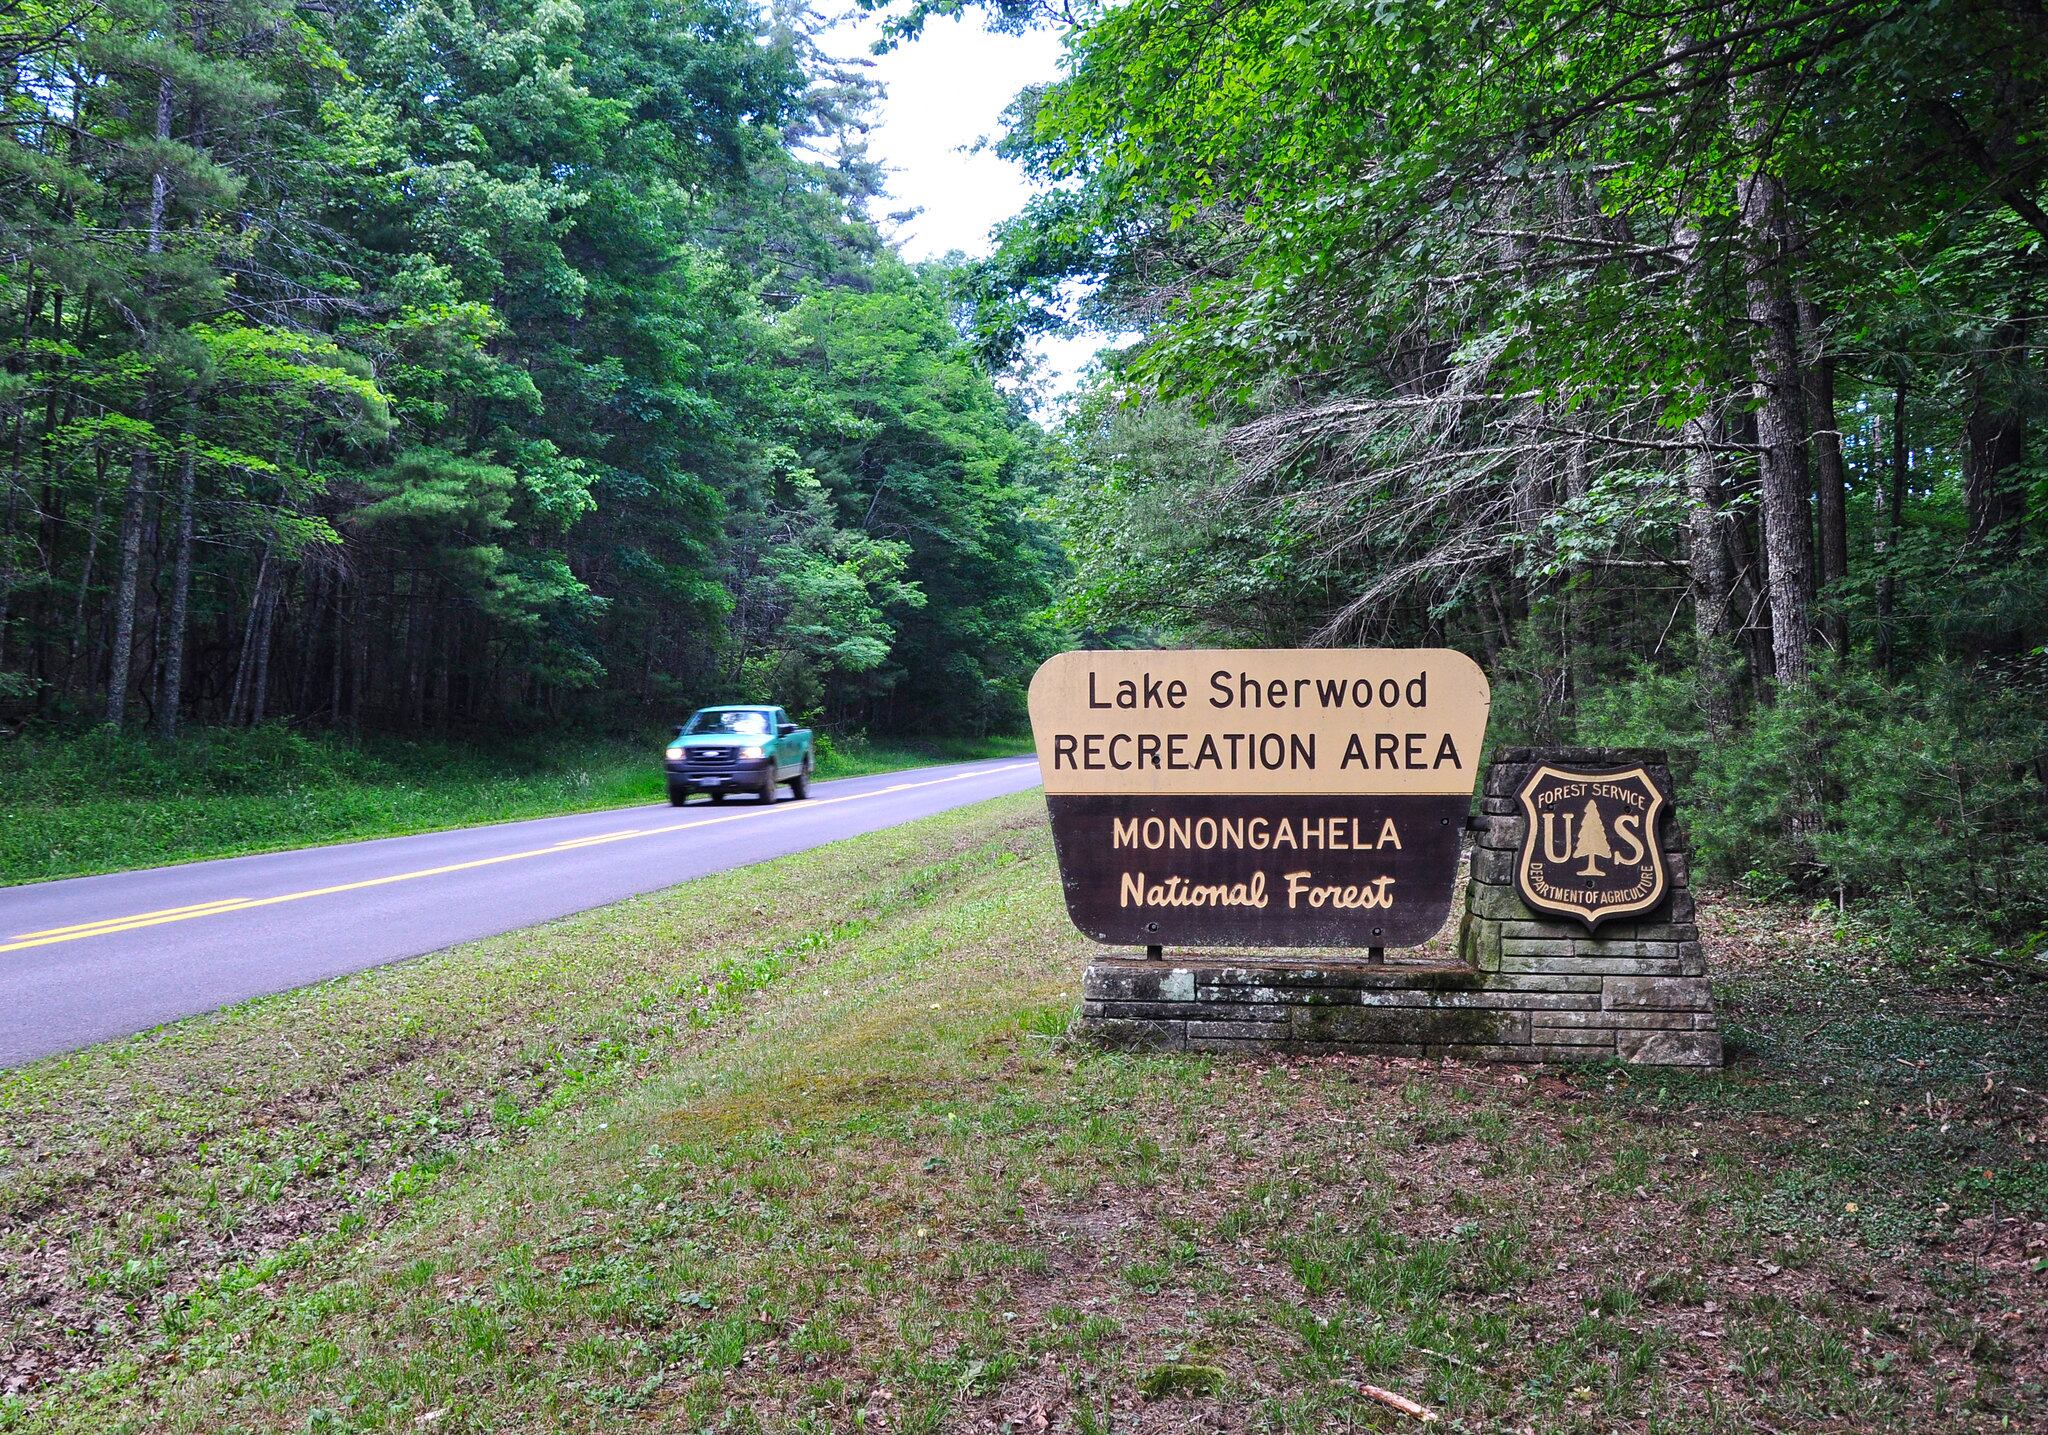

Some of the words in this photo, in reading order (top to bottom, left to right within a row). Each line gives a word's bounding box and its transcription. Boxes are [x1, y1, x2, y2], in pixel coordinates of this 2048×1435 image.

[1088, 671, 1188, 709] Lake
[1209, 670, 1427, 708] Sherwood
[1054, 733, 1316, 770] RECREATION
[1340, 733, 1463, 770] AREA
[1538, 783, 1588, 809] FOREST
[1592, 783, 1645, 811] SERVICE
[1112, 817, 1402, 849] MONONGAHELA
[1120, 872, 1268, 908] National
[1284, 871, 1396, 909] Forest
[1530, 862, 1584, 903] DEPARTMENT
[1585, 890, 1599, 904] OF
[1601, 865, 1653, 904] AGRICULTURE
